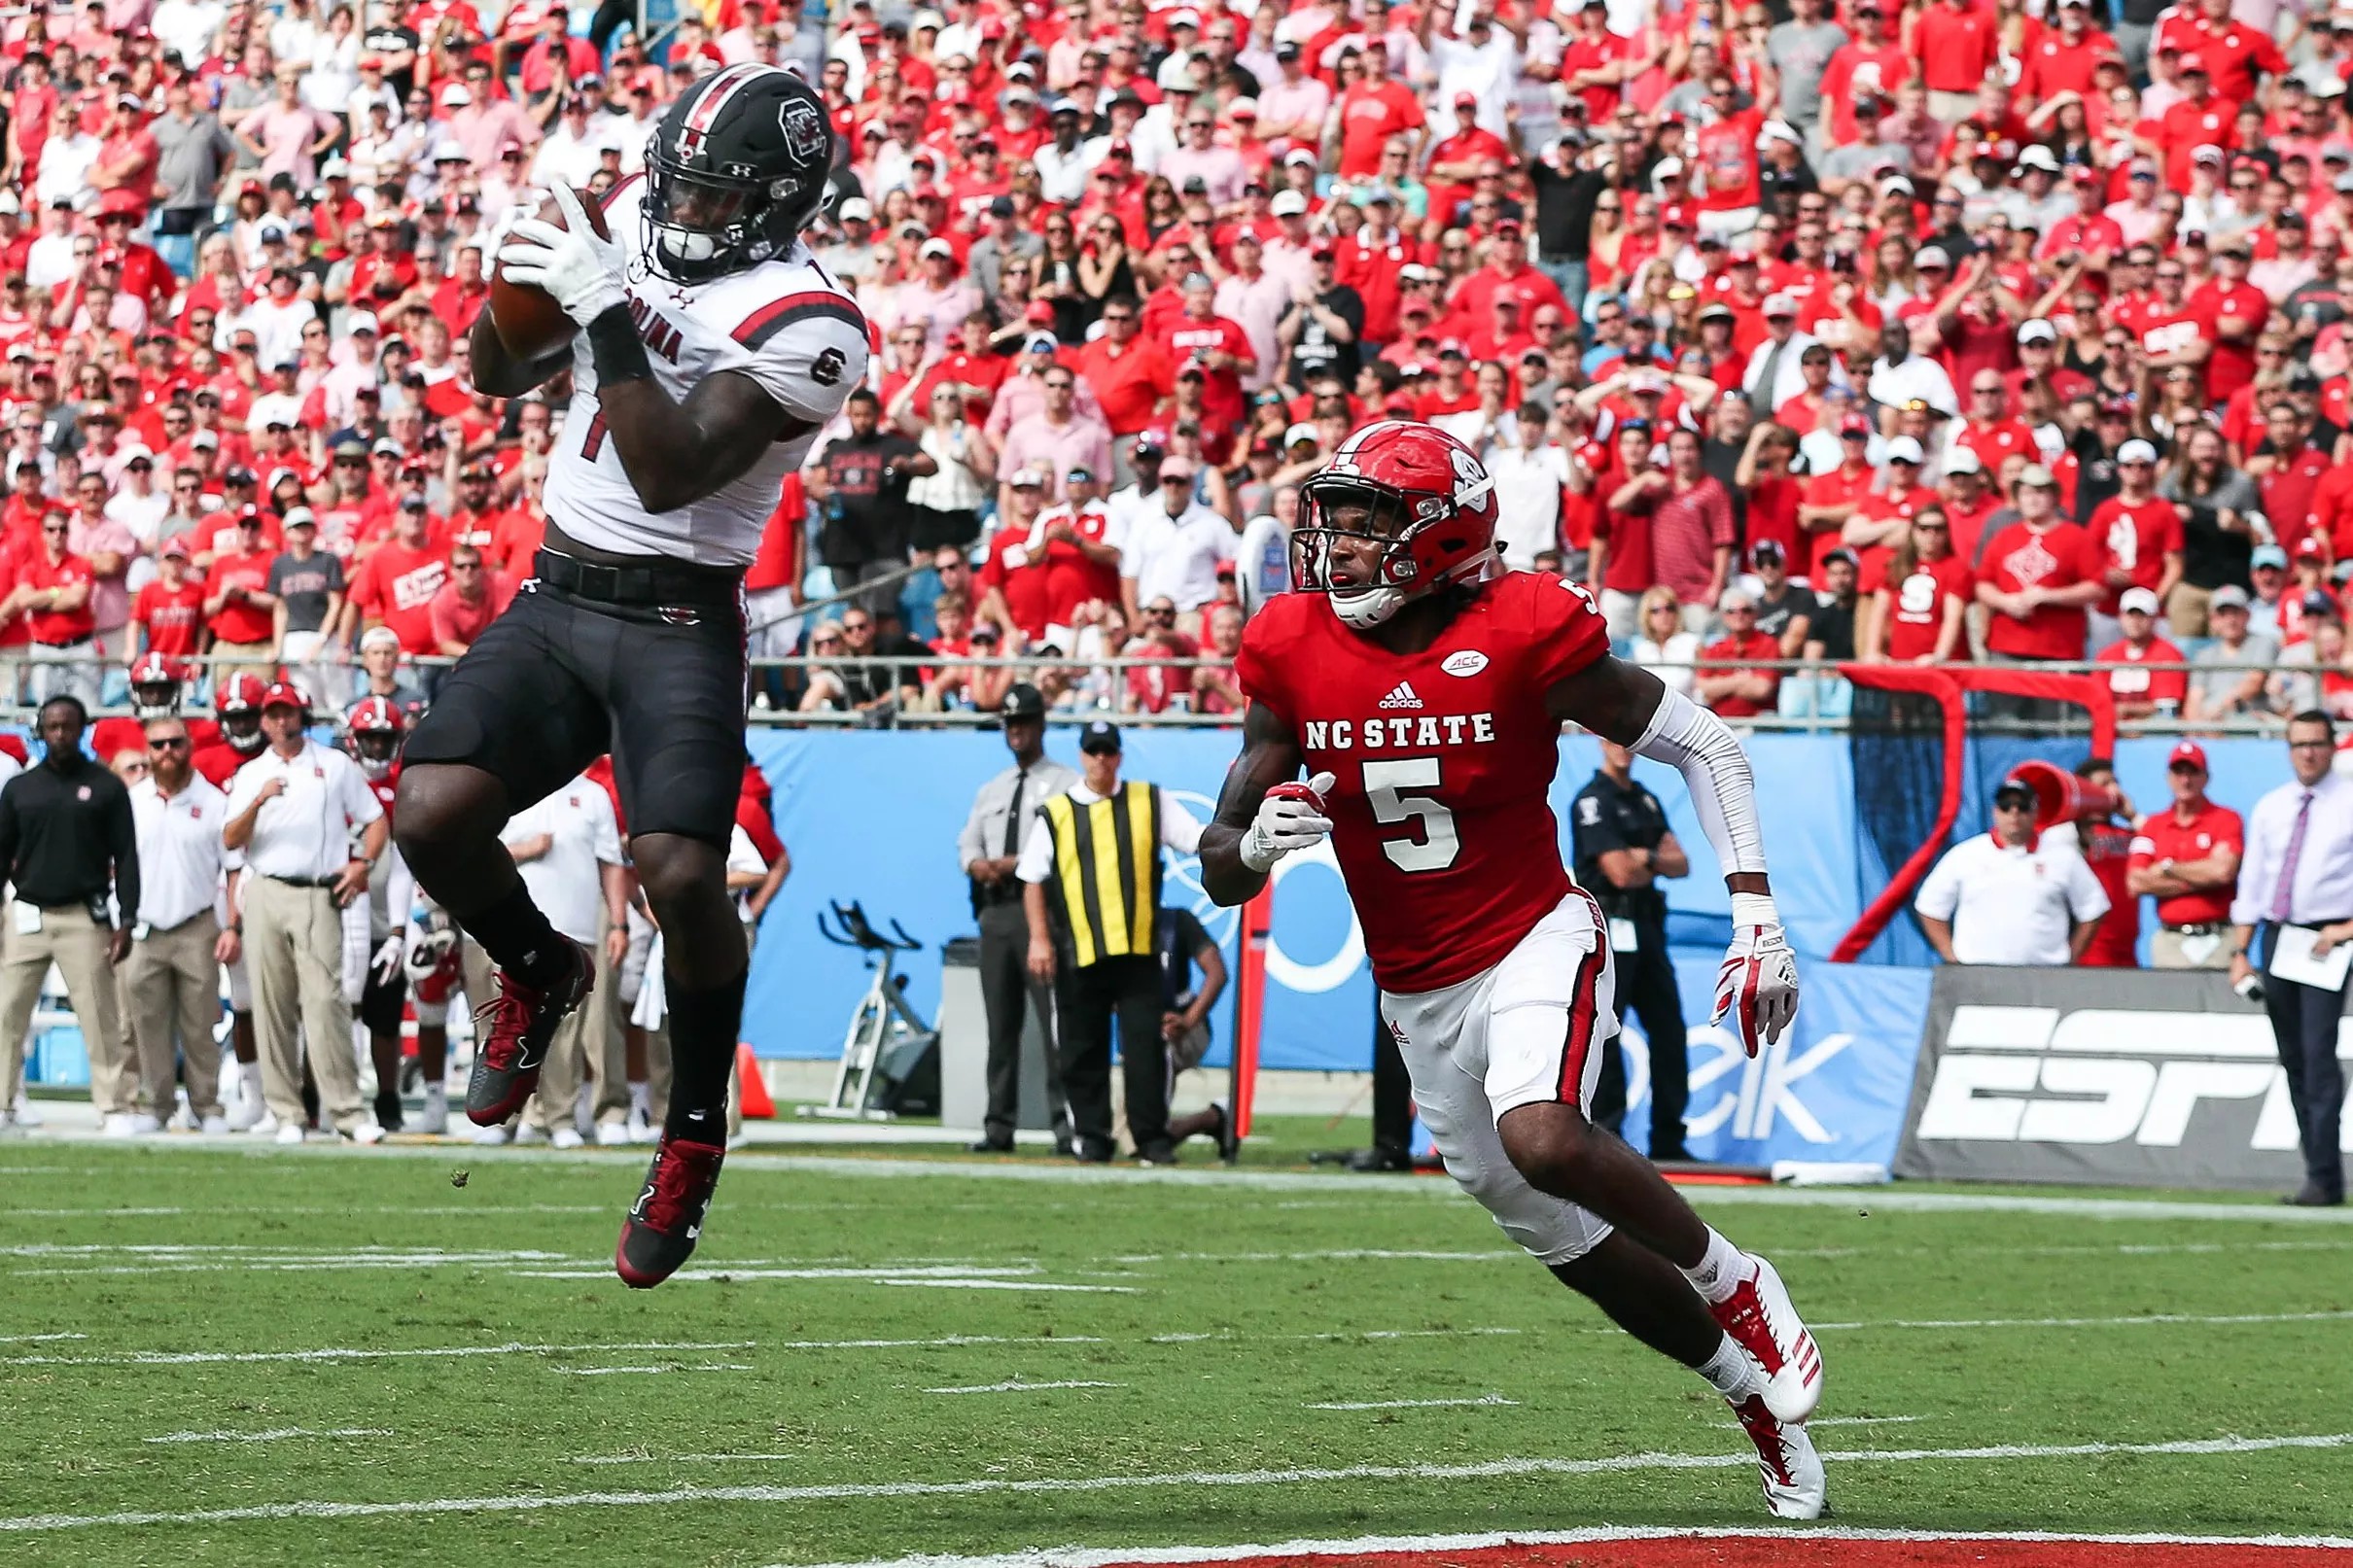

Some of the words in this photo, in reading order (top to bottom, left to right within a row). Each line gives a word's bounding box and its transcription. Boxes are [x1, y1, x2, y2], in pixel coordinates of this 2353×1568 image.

[1450, 655, 1480, 670] ACC
[1379, 698, 1423, 710] adidas
[1306, 720, 1352, 749] NC
[1364, 713, 1495, 748] STATE
[1362, 757, 1459, 872] 5
